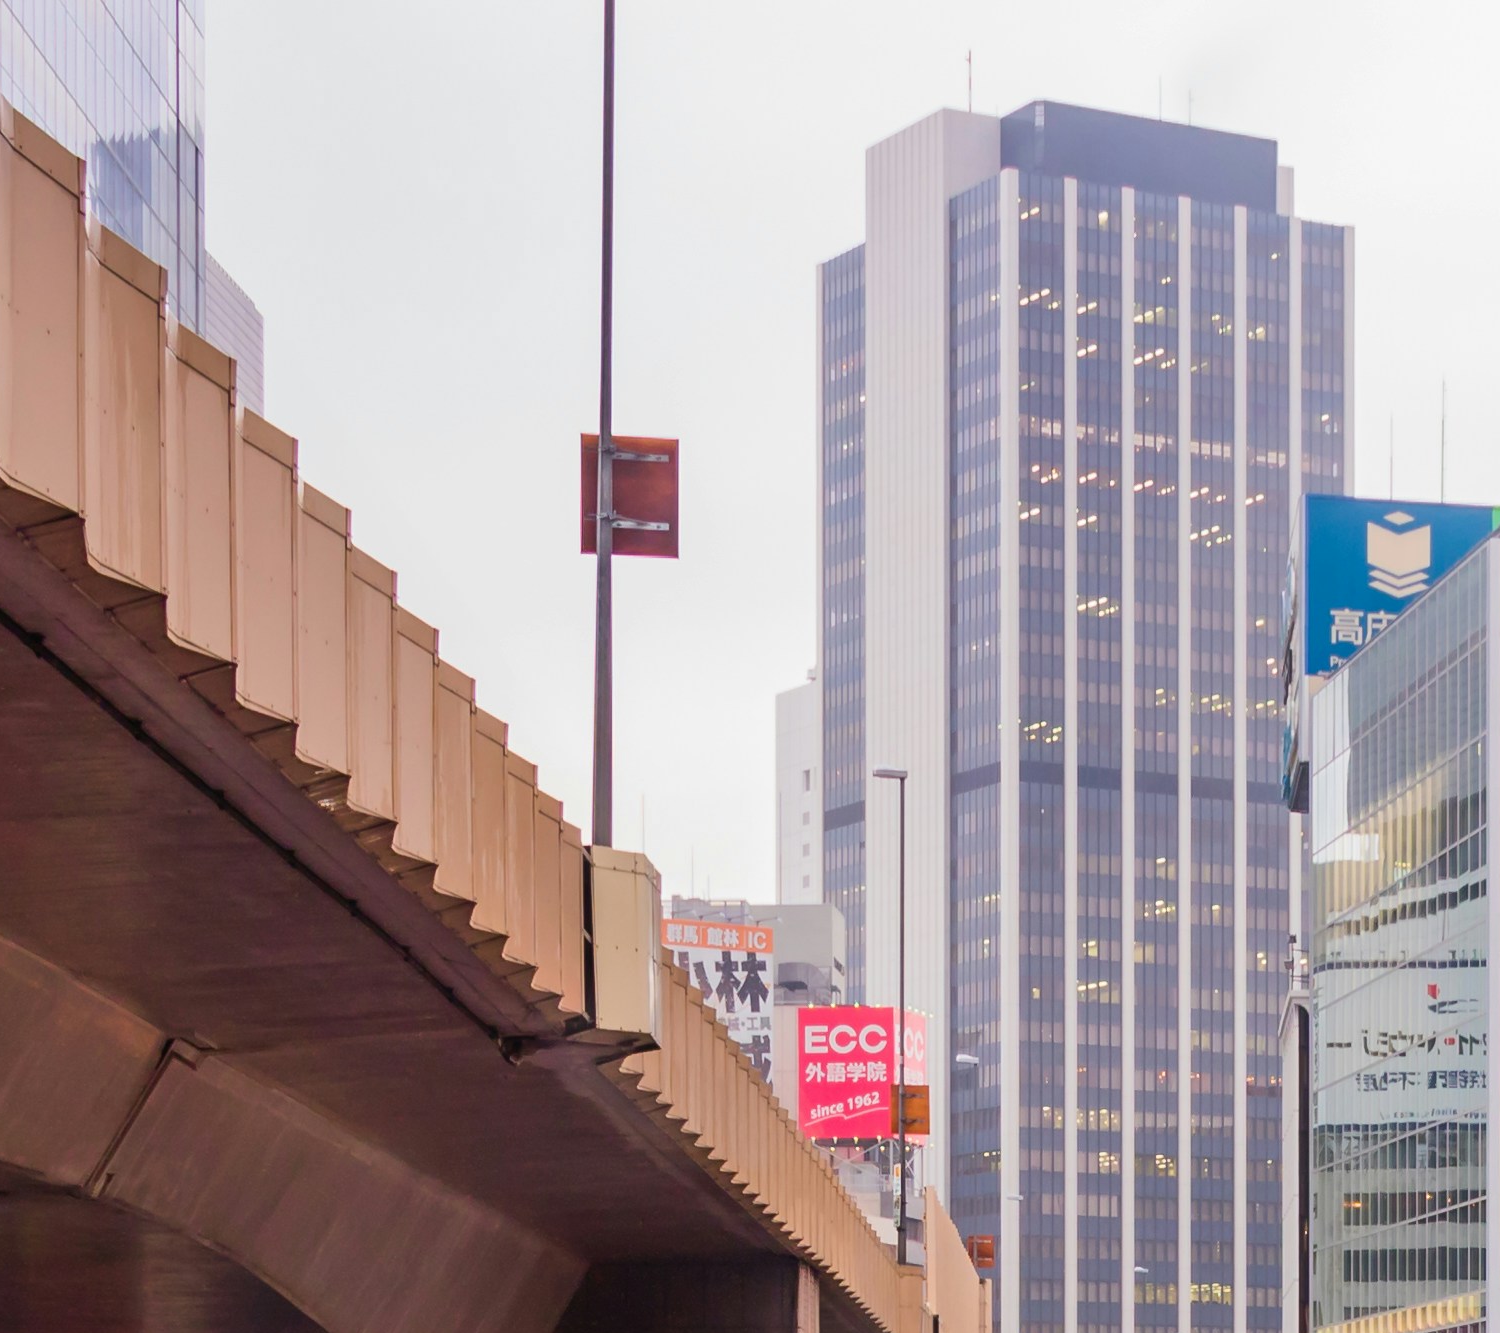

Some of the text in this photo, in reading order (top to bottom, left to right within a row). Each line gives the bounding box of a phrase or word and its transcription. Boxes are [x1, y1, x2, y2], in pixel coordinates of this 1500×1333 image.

[804, 1024, 888, 1054] ECC
[805, 1061, 888, 1083] 外語学院
[810, 1091, 880, 1119] since 1962
